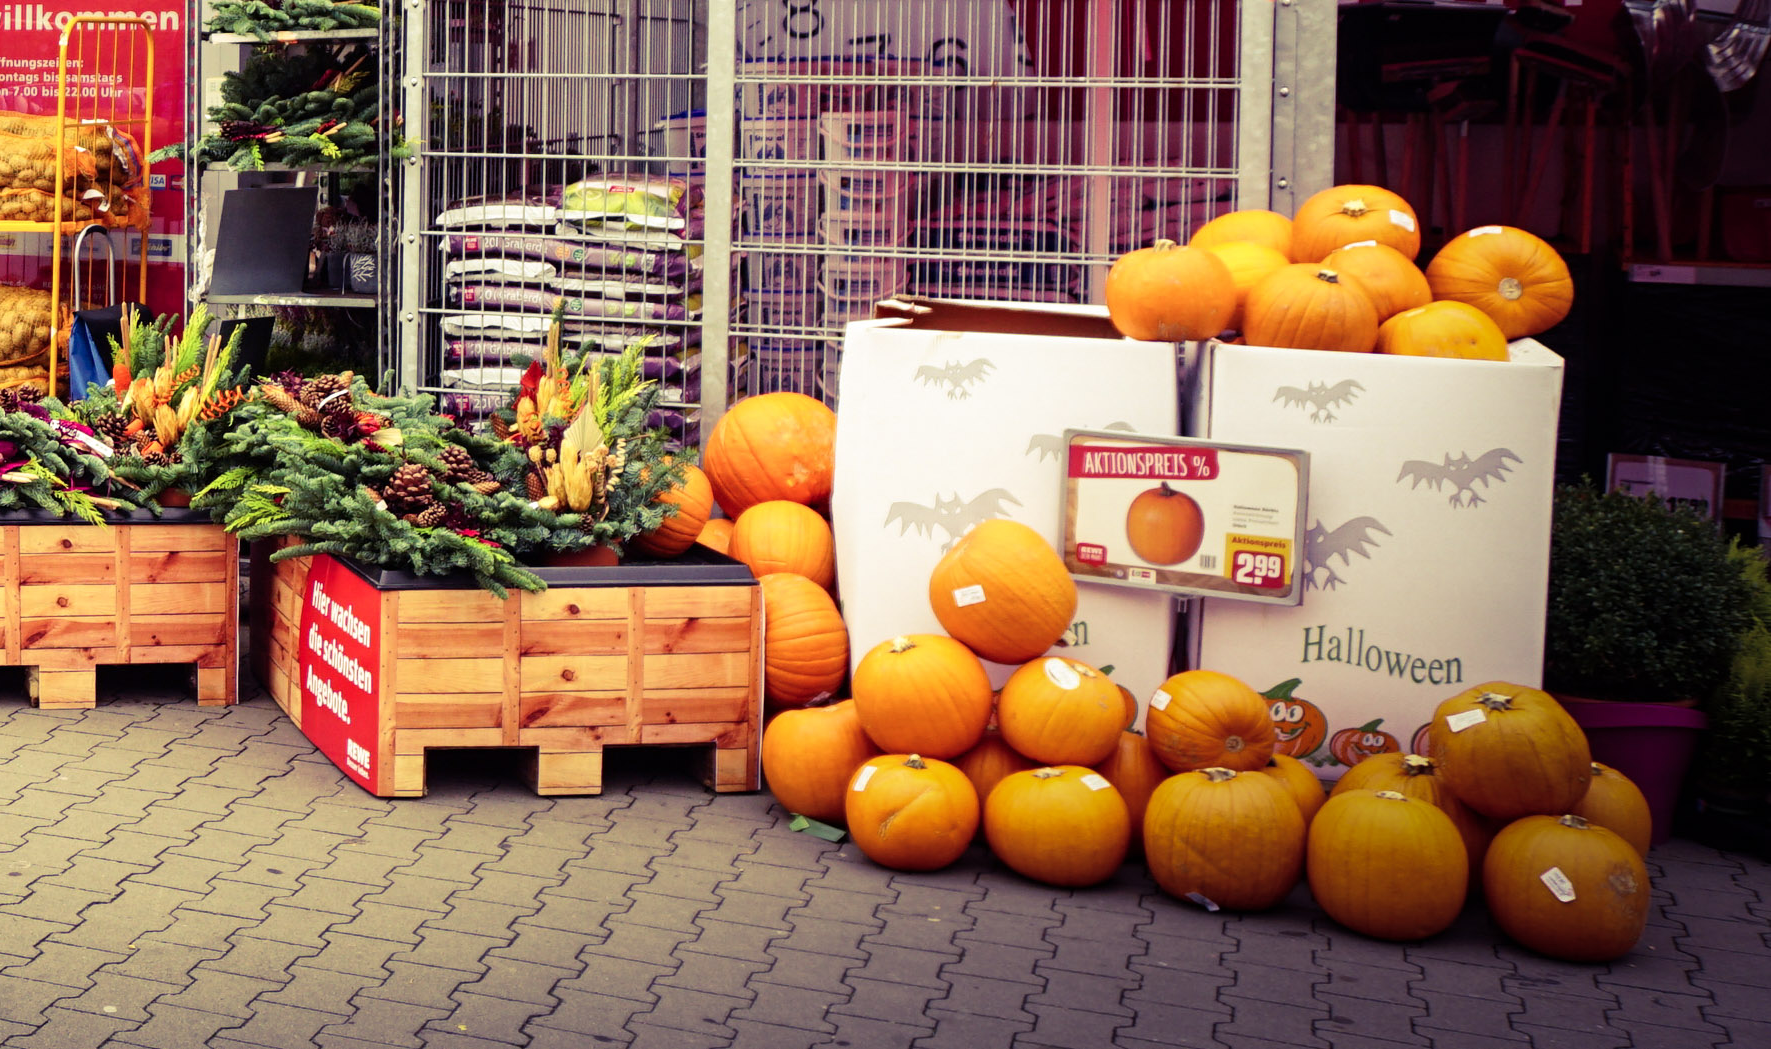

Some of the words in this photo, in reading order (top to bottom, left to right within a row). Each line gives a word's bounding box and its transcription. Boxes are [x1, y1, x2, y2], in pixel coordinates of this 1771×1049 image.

[42, 71, 60, 83] bis
[65, 72, 123, 85] samstags
[13, 86, 38, 97] 7.00
[41, 86, 60, 97] bis
[64, 86, 98, 98] 22.00
[100, 86, 123, 98] Uhr
[149, 175, 166, 188] ISA
[503, 236, 547, 253] Graerd
[1084, 451, 1188, 477] AKTIONSPREIS
[1192, 455, 1211, 477] %
[1080, 546, 1104, 555] REWE
[1231, 535, 1287, 550] Aktionspreis
[1235, 551, 1282, 586] 2.99
[312, 580, 330, 617] Hier
[331, 597, 371, 649] wachsen
[308, 622, 322, 656] die
[323, 637, 372, 694] schönsten
[1299, 623, 1464, 687] Halloween
[307, 664, 351, 725] Angebote.
[347, 738, 371, 770] REWE
